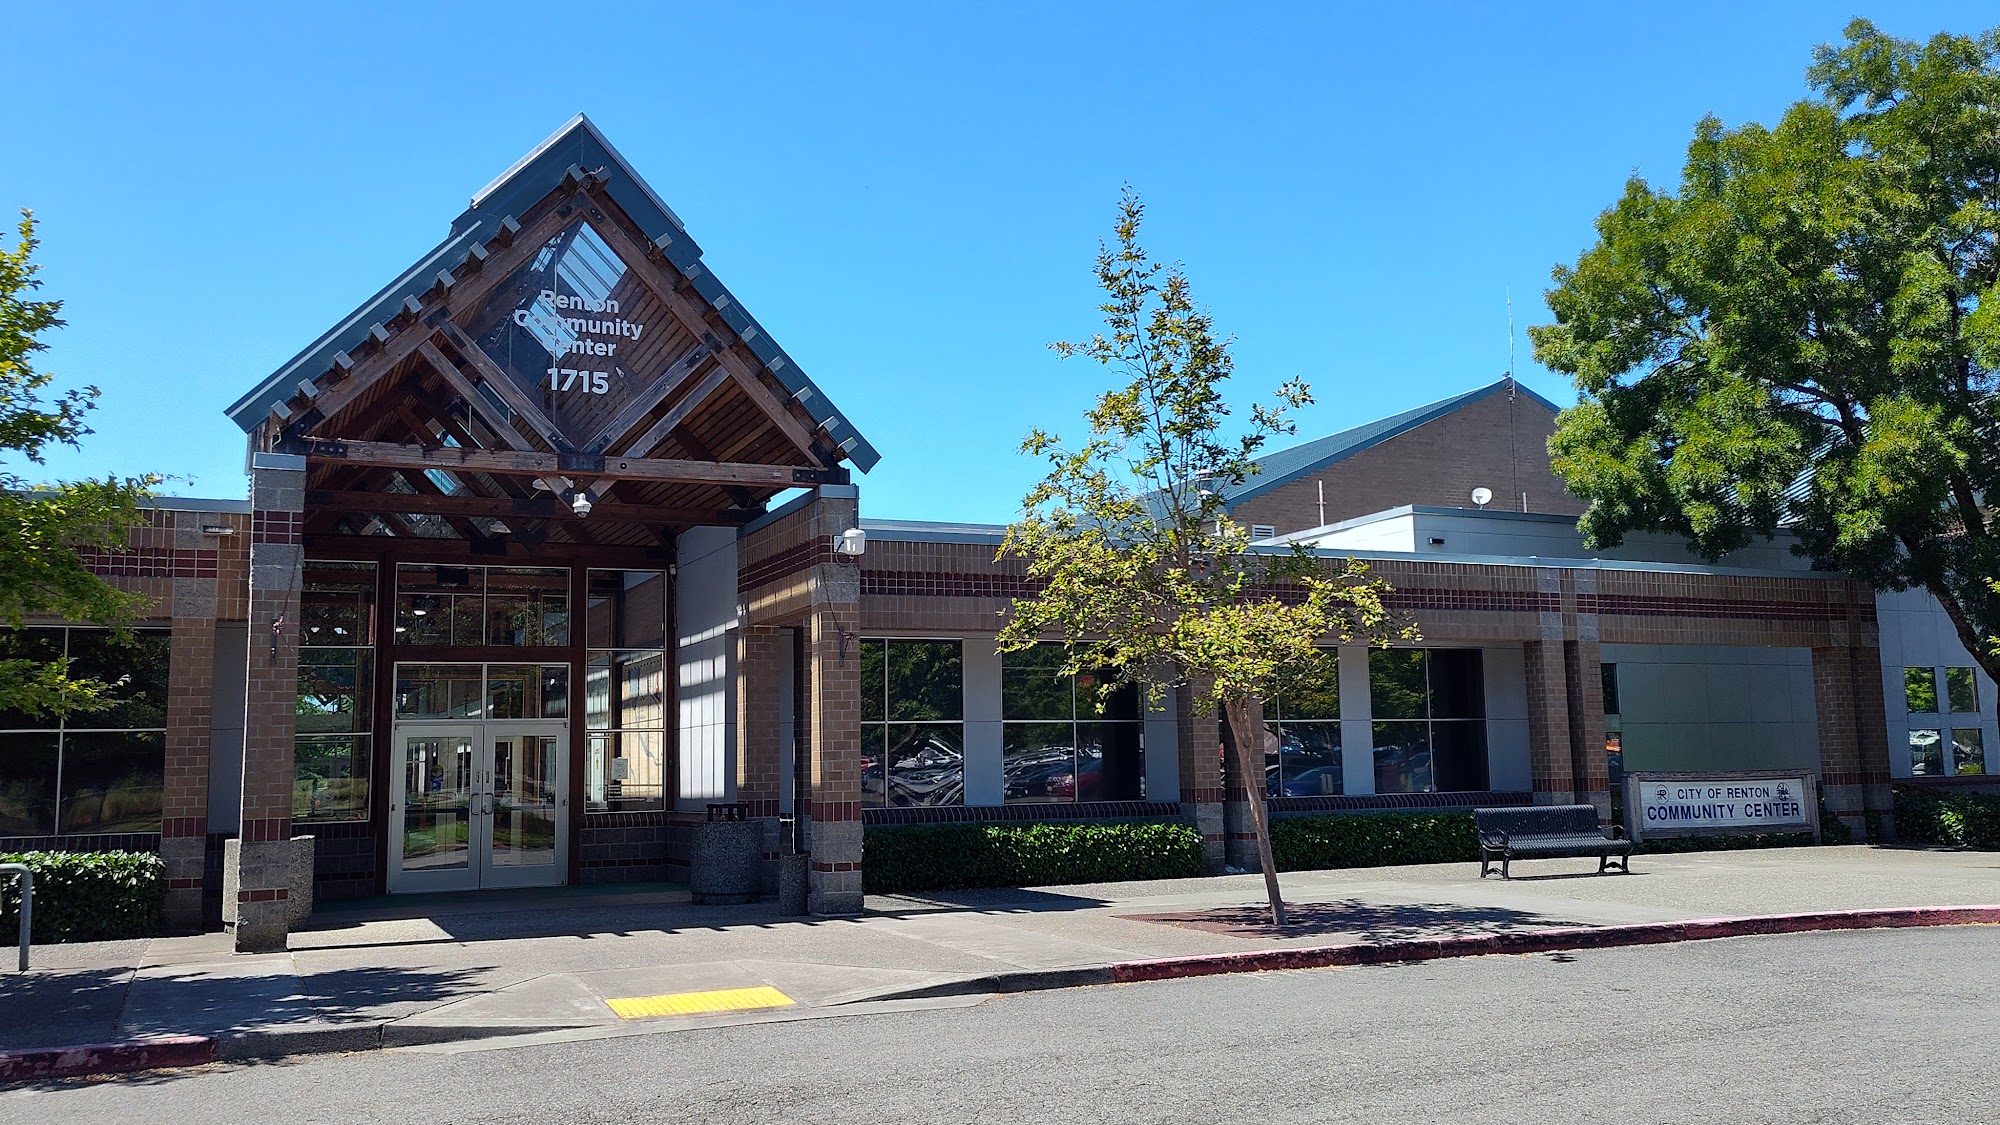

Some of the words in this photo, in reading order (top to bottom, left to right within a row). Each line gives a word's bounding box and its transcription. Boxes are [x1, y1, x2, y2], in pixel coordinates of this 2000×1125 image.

[540, 289, 619, 314] Renton
[514, 309, 644, 341] Community
[542, 334, 617, 357] Center
[547, 368, 609, 394] 1715
[1677, 788, 1702, 800] CITY
[1707, 787, 1722, 799] OF
[1727, 786, 1770, 799] RENTON
[1647, 804, 1735, 820] COMMUNITY
[1744, 802, 1800, 818] CENTER
